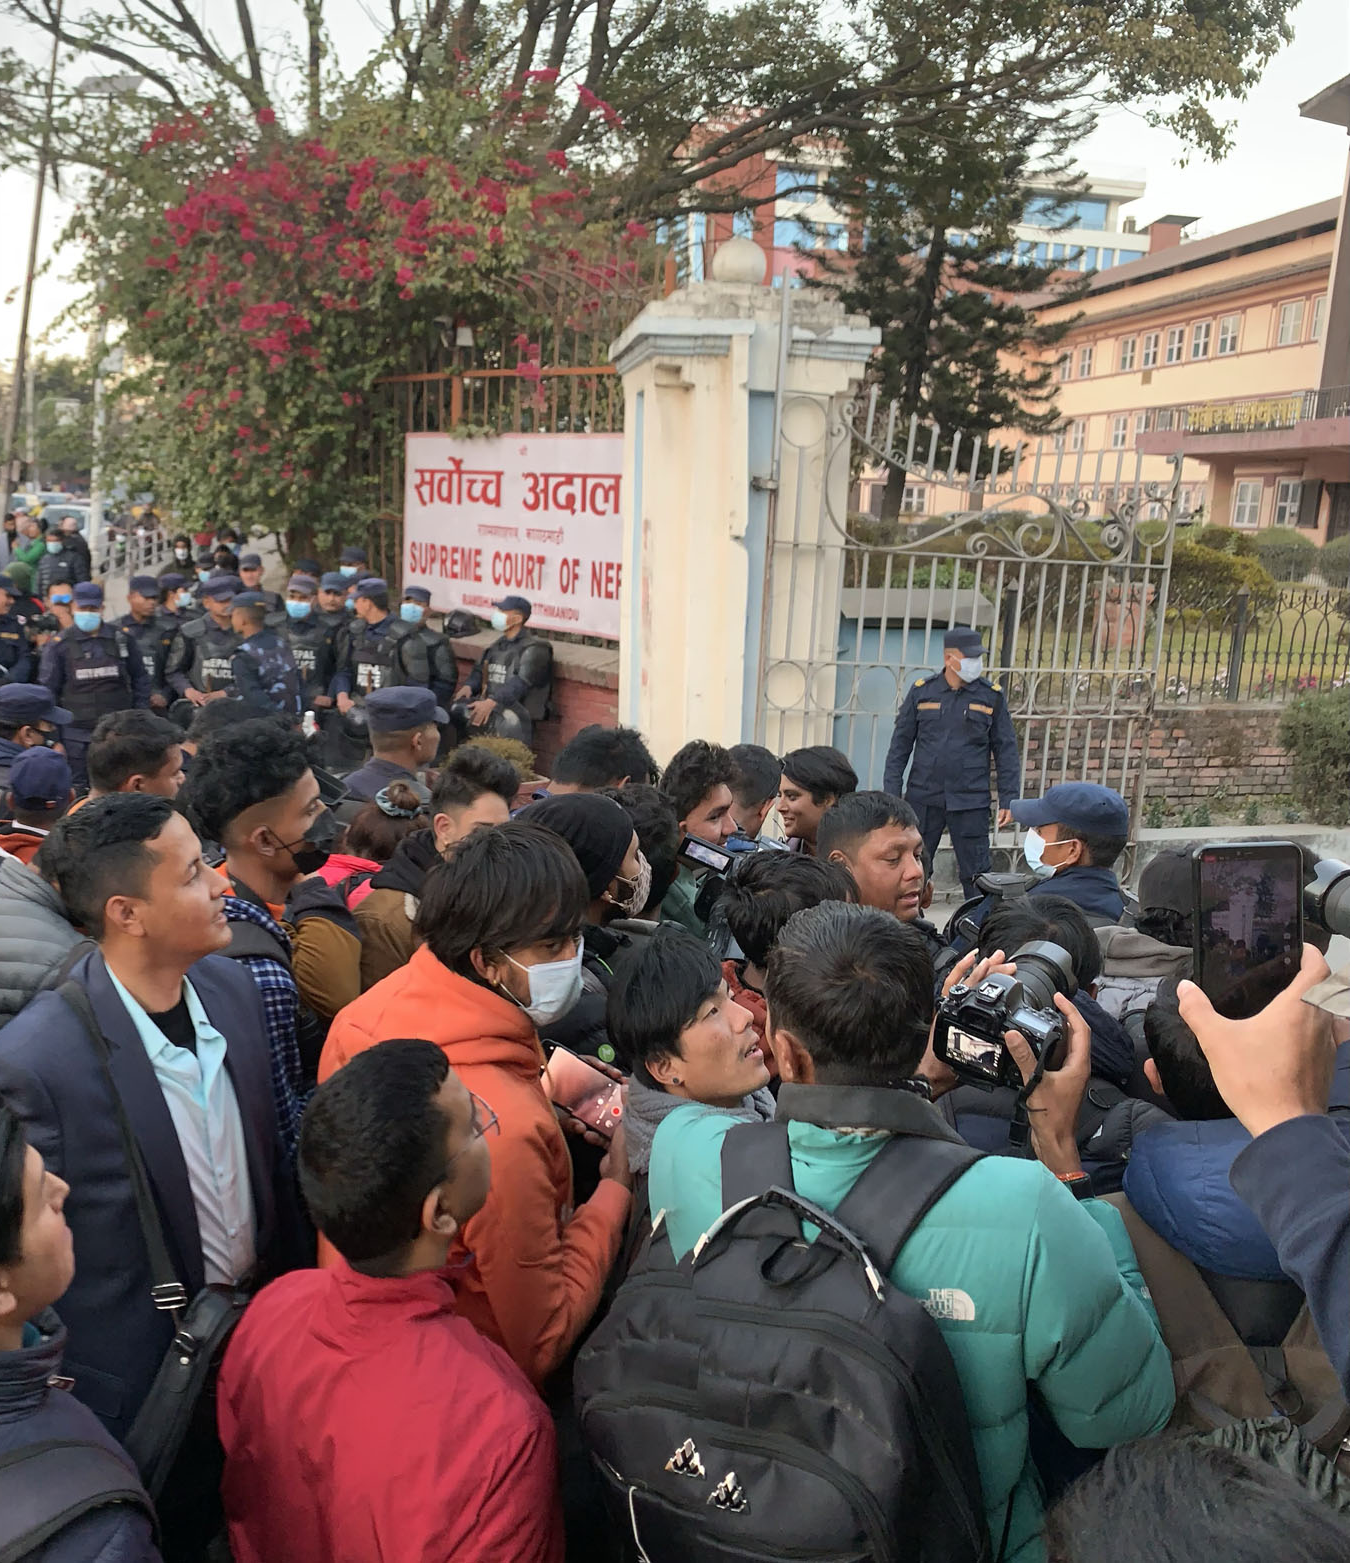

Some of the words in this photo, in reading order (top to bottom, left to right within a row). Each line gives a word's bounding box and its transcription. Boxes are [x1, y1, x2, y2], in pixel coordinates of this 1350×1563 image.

[414, 456, 504, 508] सर्वोच्च
[522, 472, 623, 516] अदाल
[410, 541, 483, 583] SUPREME
[492, 551, 546, 591] COURT
[560, 557, 580, 595] OF
[591, 560, 623, 601] NEP
[292, 650, 315, 660] EPAL
[928, 1288, 953, 1300] THE
[918, 1299, 953, 1311] ORTH
